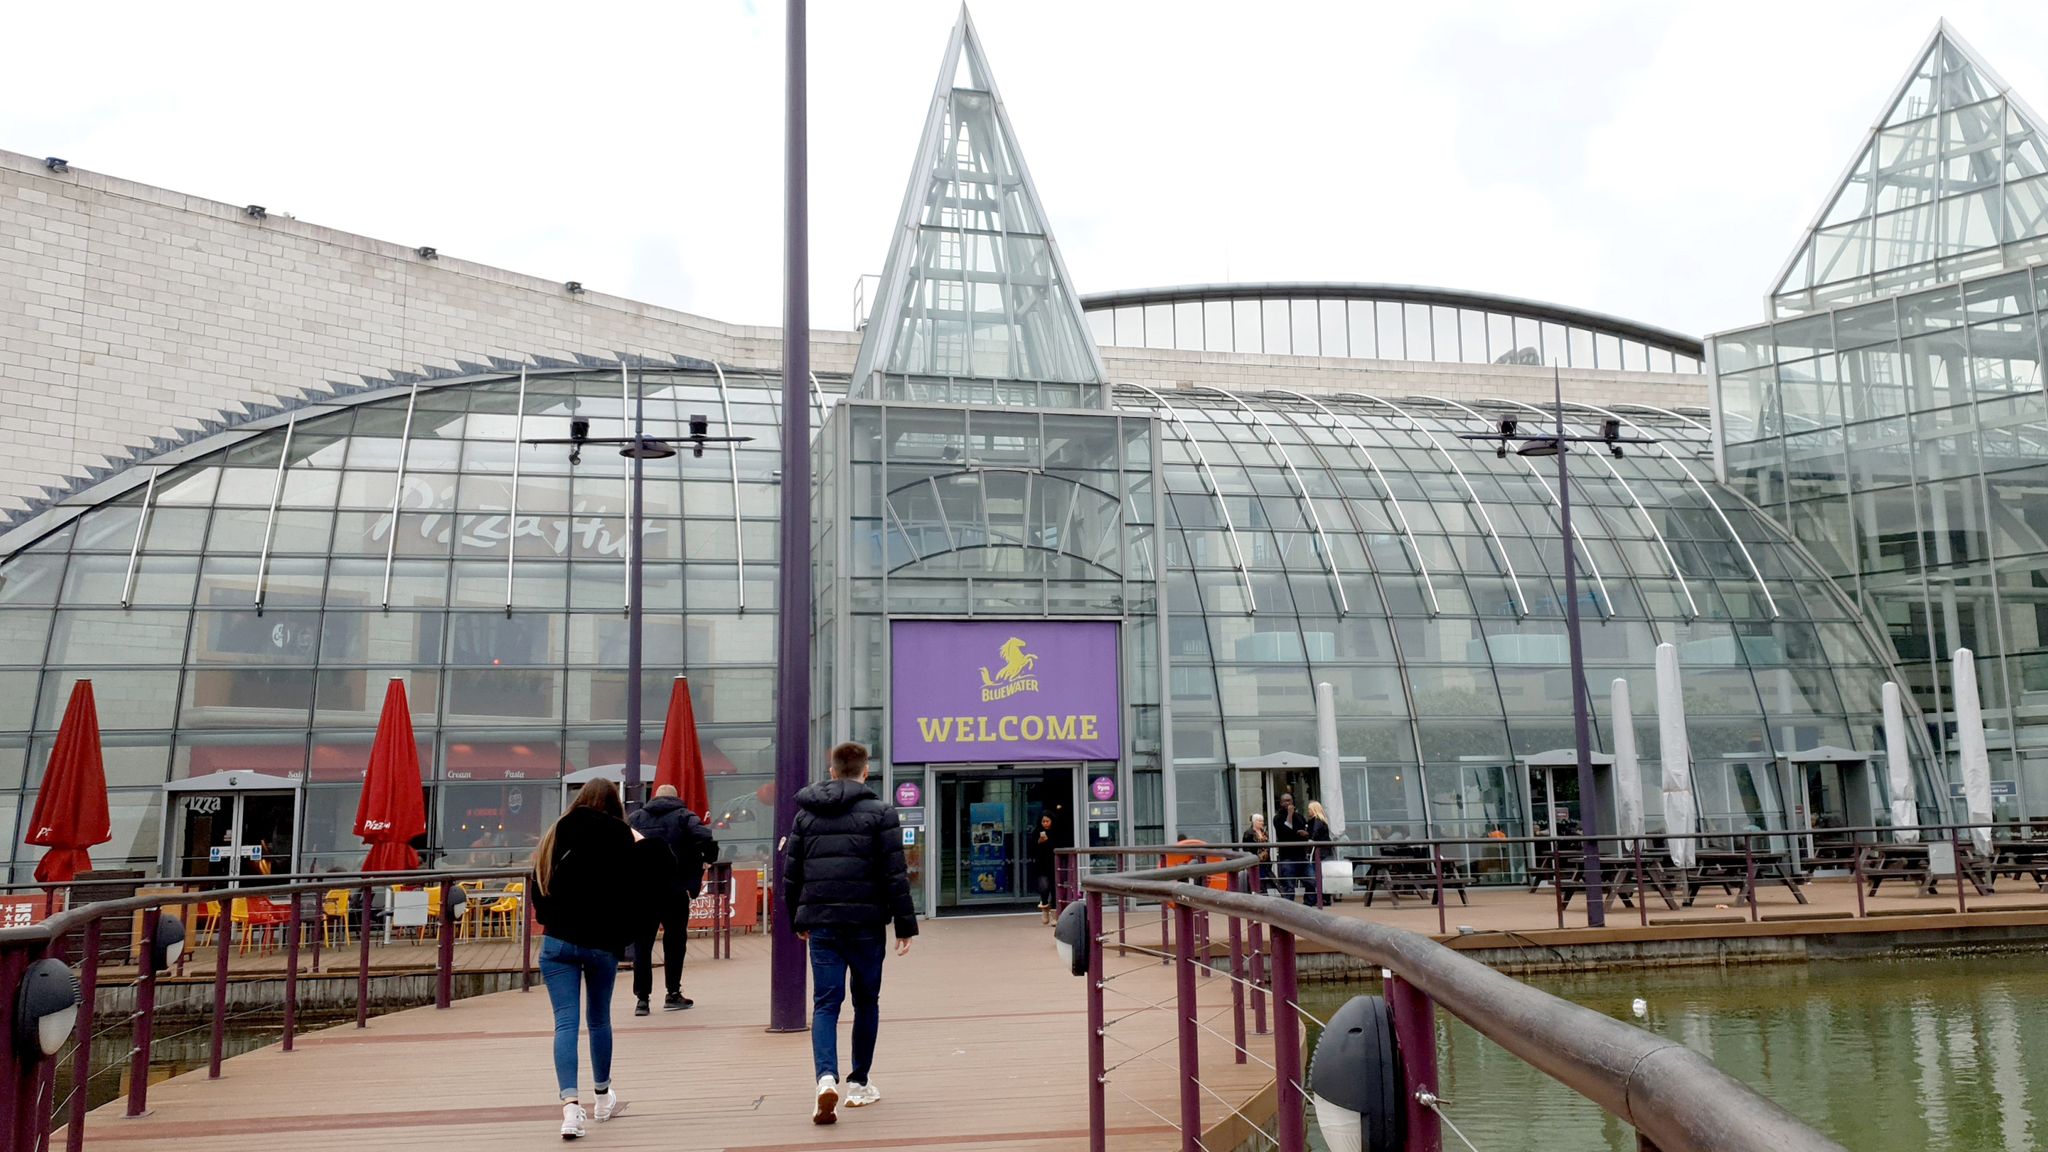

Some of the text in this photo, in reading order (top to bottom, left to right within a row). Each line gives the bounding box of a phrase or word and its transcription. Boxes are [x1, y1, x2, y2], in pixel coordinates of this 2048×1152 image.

[372, 477, 544, 548] Pizza
[982, 679, 1039, 702] BLUEWATER
[917, 715, 1099, 743] WELCOME
[504, 769, 525, 778] Pasta
